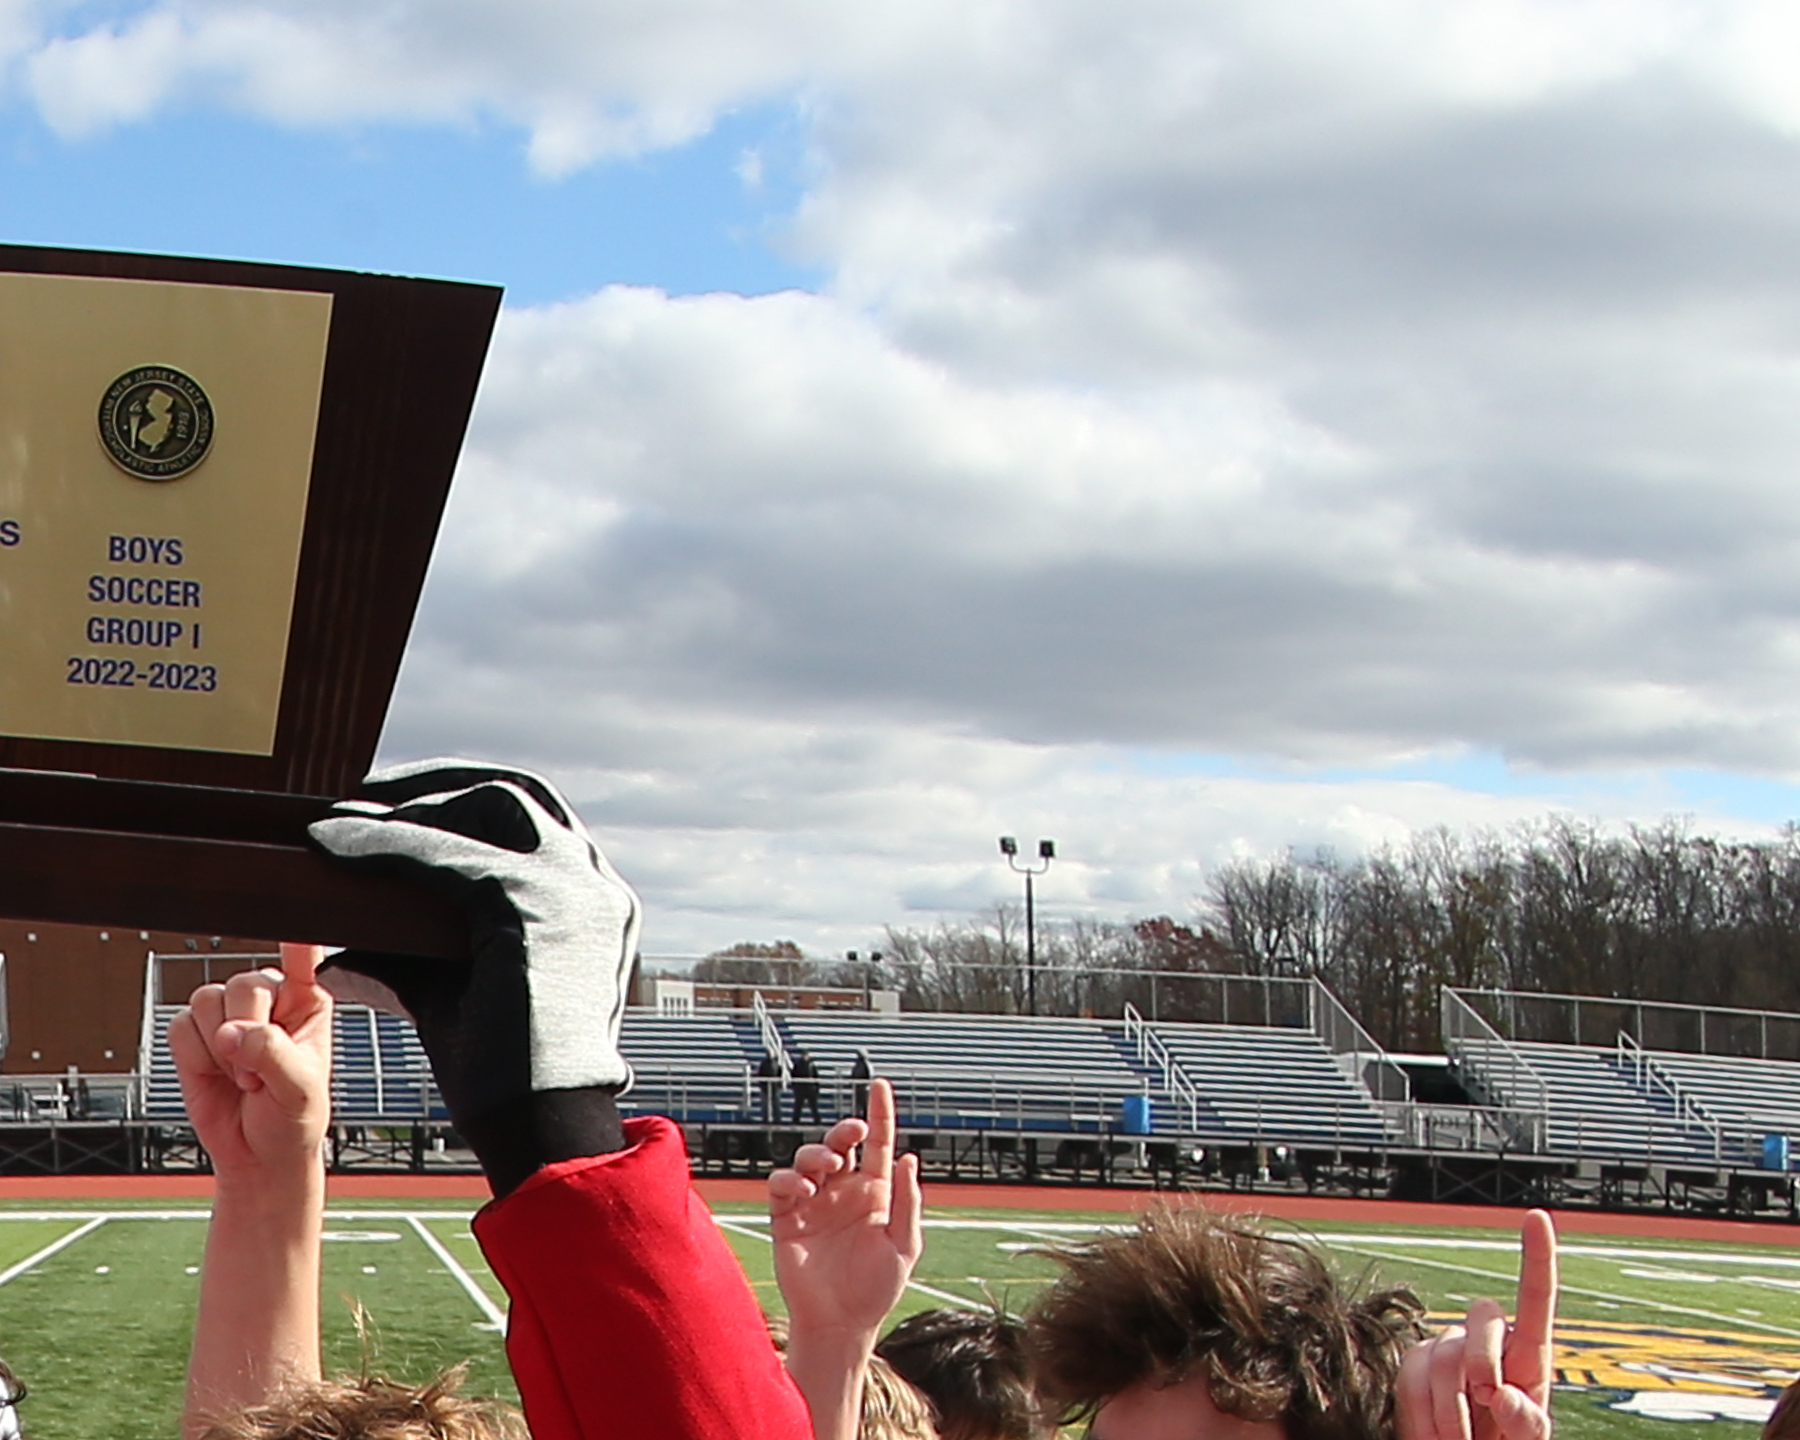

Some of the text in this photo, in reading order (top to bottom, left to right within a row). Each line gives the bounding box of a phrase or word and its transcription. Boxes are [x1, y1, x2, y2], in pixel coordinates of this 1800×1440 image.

[108, 534, 184, 566] BOYS
[86, 574, 201, 609] SOCCER
[85, 615, 184, 649] GROUP
[66, 656, 218, 693] 2022-2023
